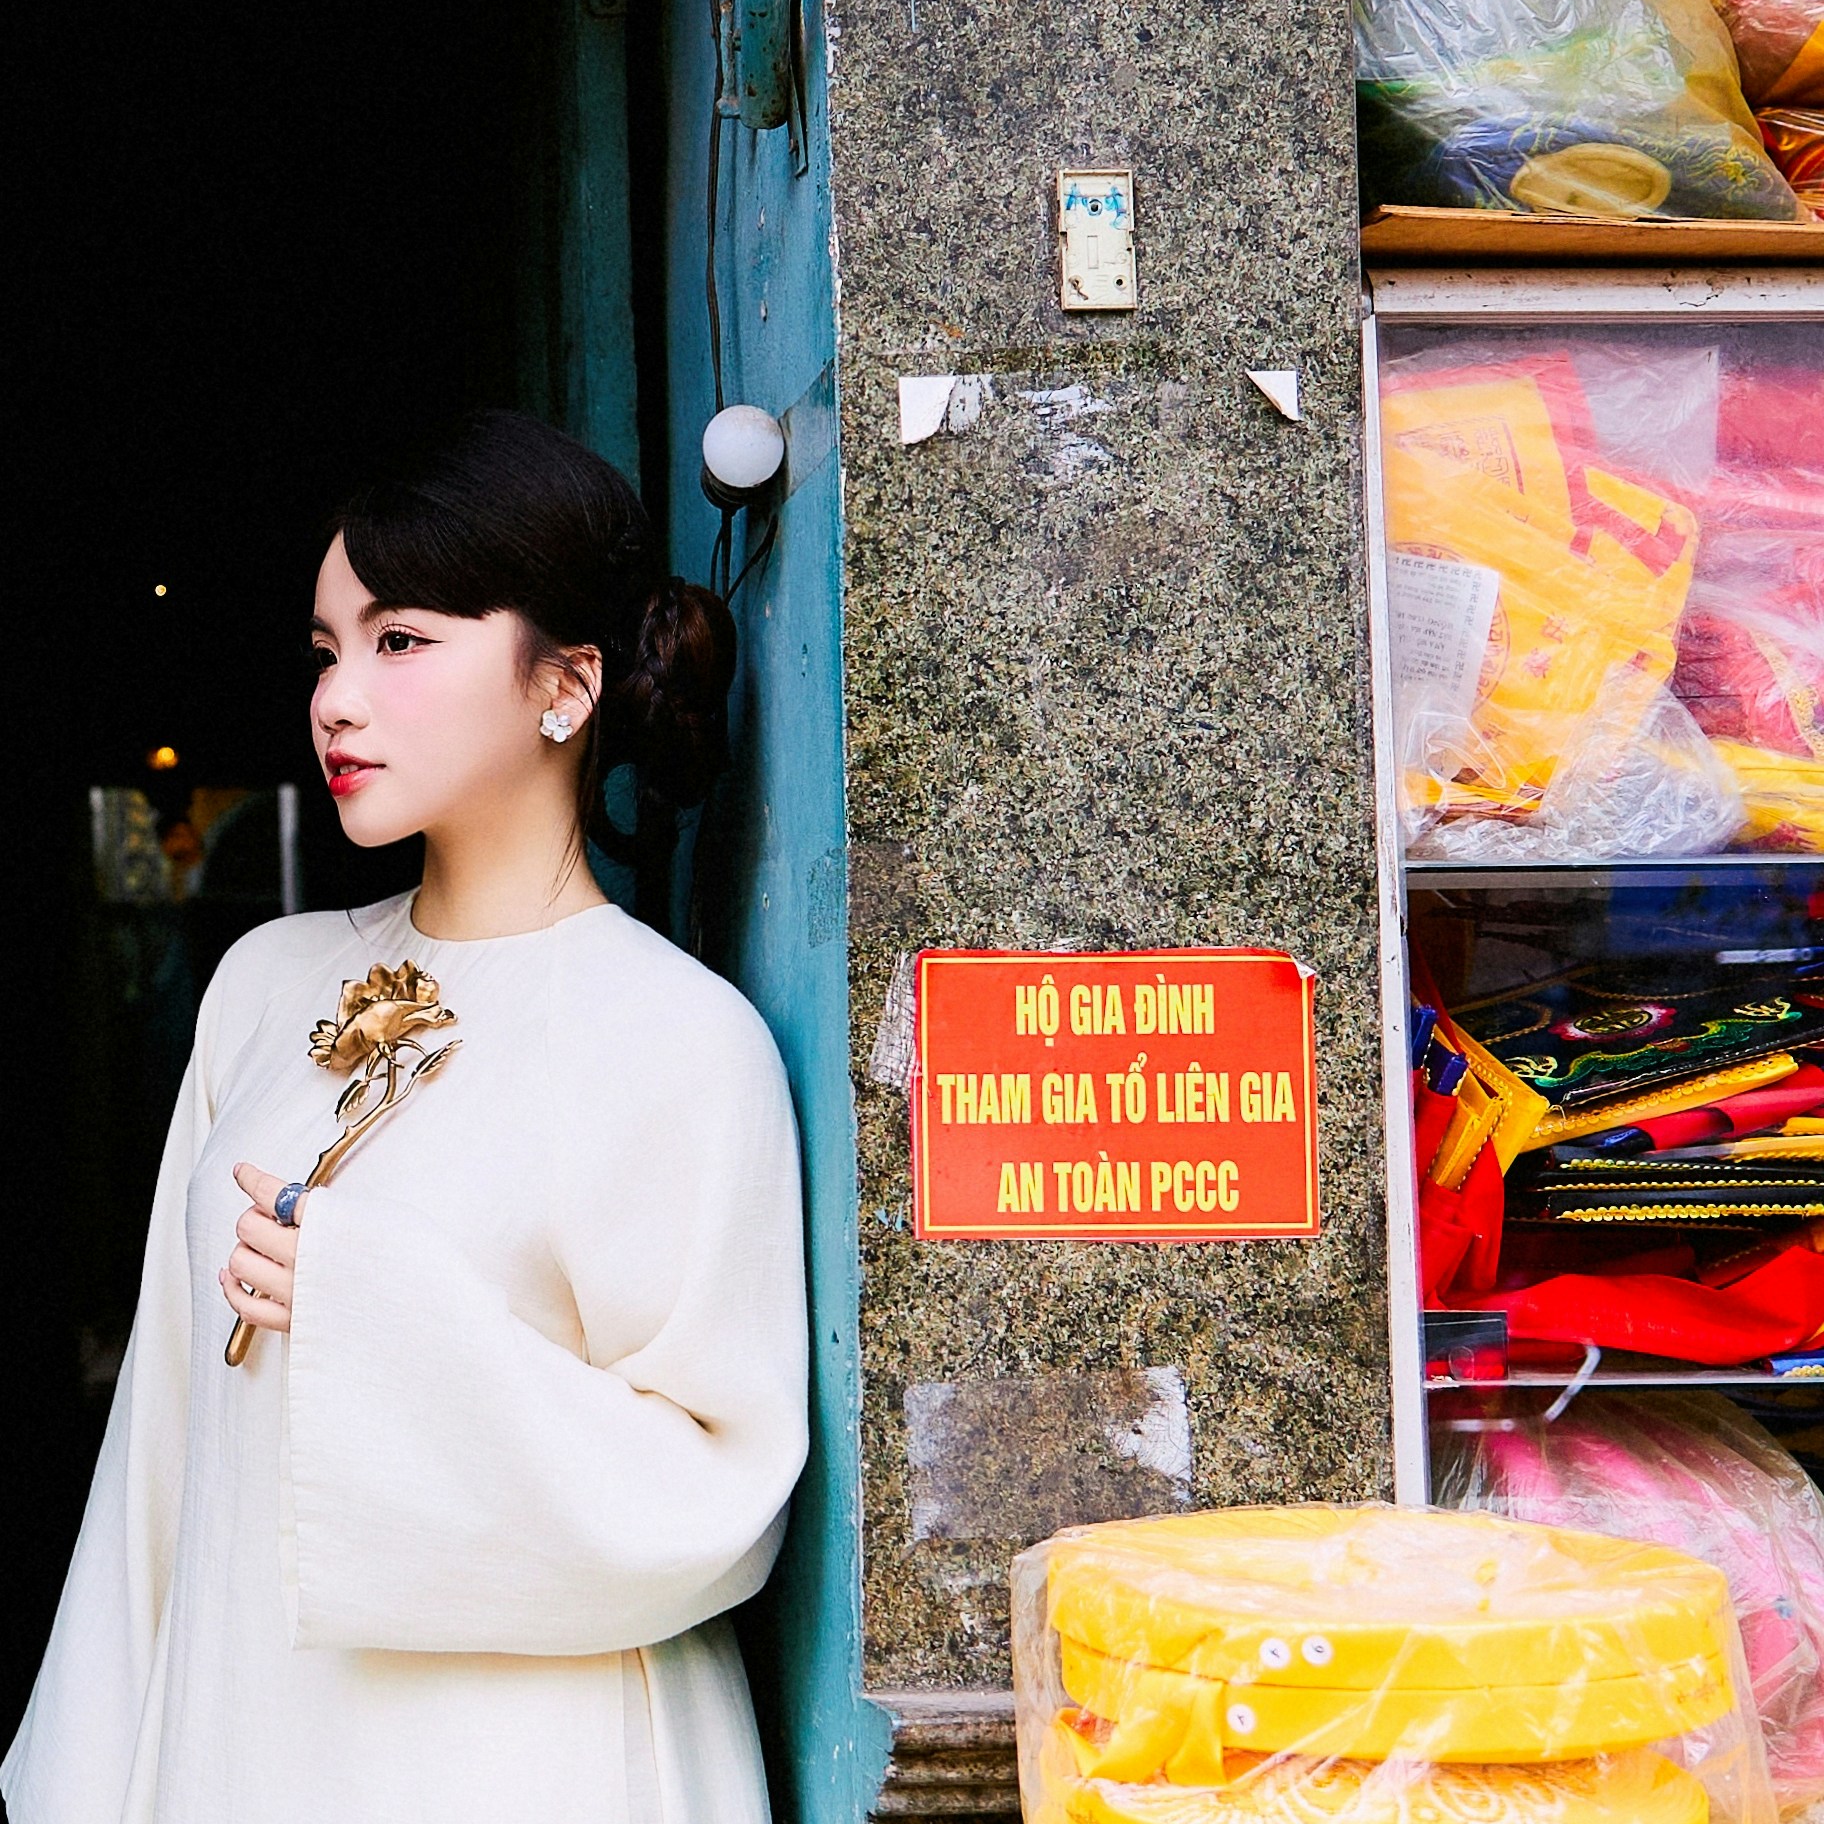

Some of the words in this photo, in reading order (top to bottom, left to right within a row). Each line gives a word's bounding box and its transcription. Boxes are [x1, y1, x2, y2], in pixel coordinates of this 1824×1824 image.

[1014, 974, 1060, 1047] HỘ
[1069, 983, 1126, 1036] GIA
[1133, 973, 1215, 1036] ĐÌNH
[936, 1073, 1031, 1125] THAM
[1041, 1073, 1098, 1125] GIA
[1106, 1051, 1148, 1124] TỔ
[1156, 1062, 1230, 1125] LIÊN
[1239, 1071, 1297, 1124] GIA
[996, 1162, 1044, 1213] AN
[1052, 1151, 1141, 1213] TOÀN
[1150, 1159, 1240, 1213] PCCC
